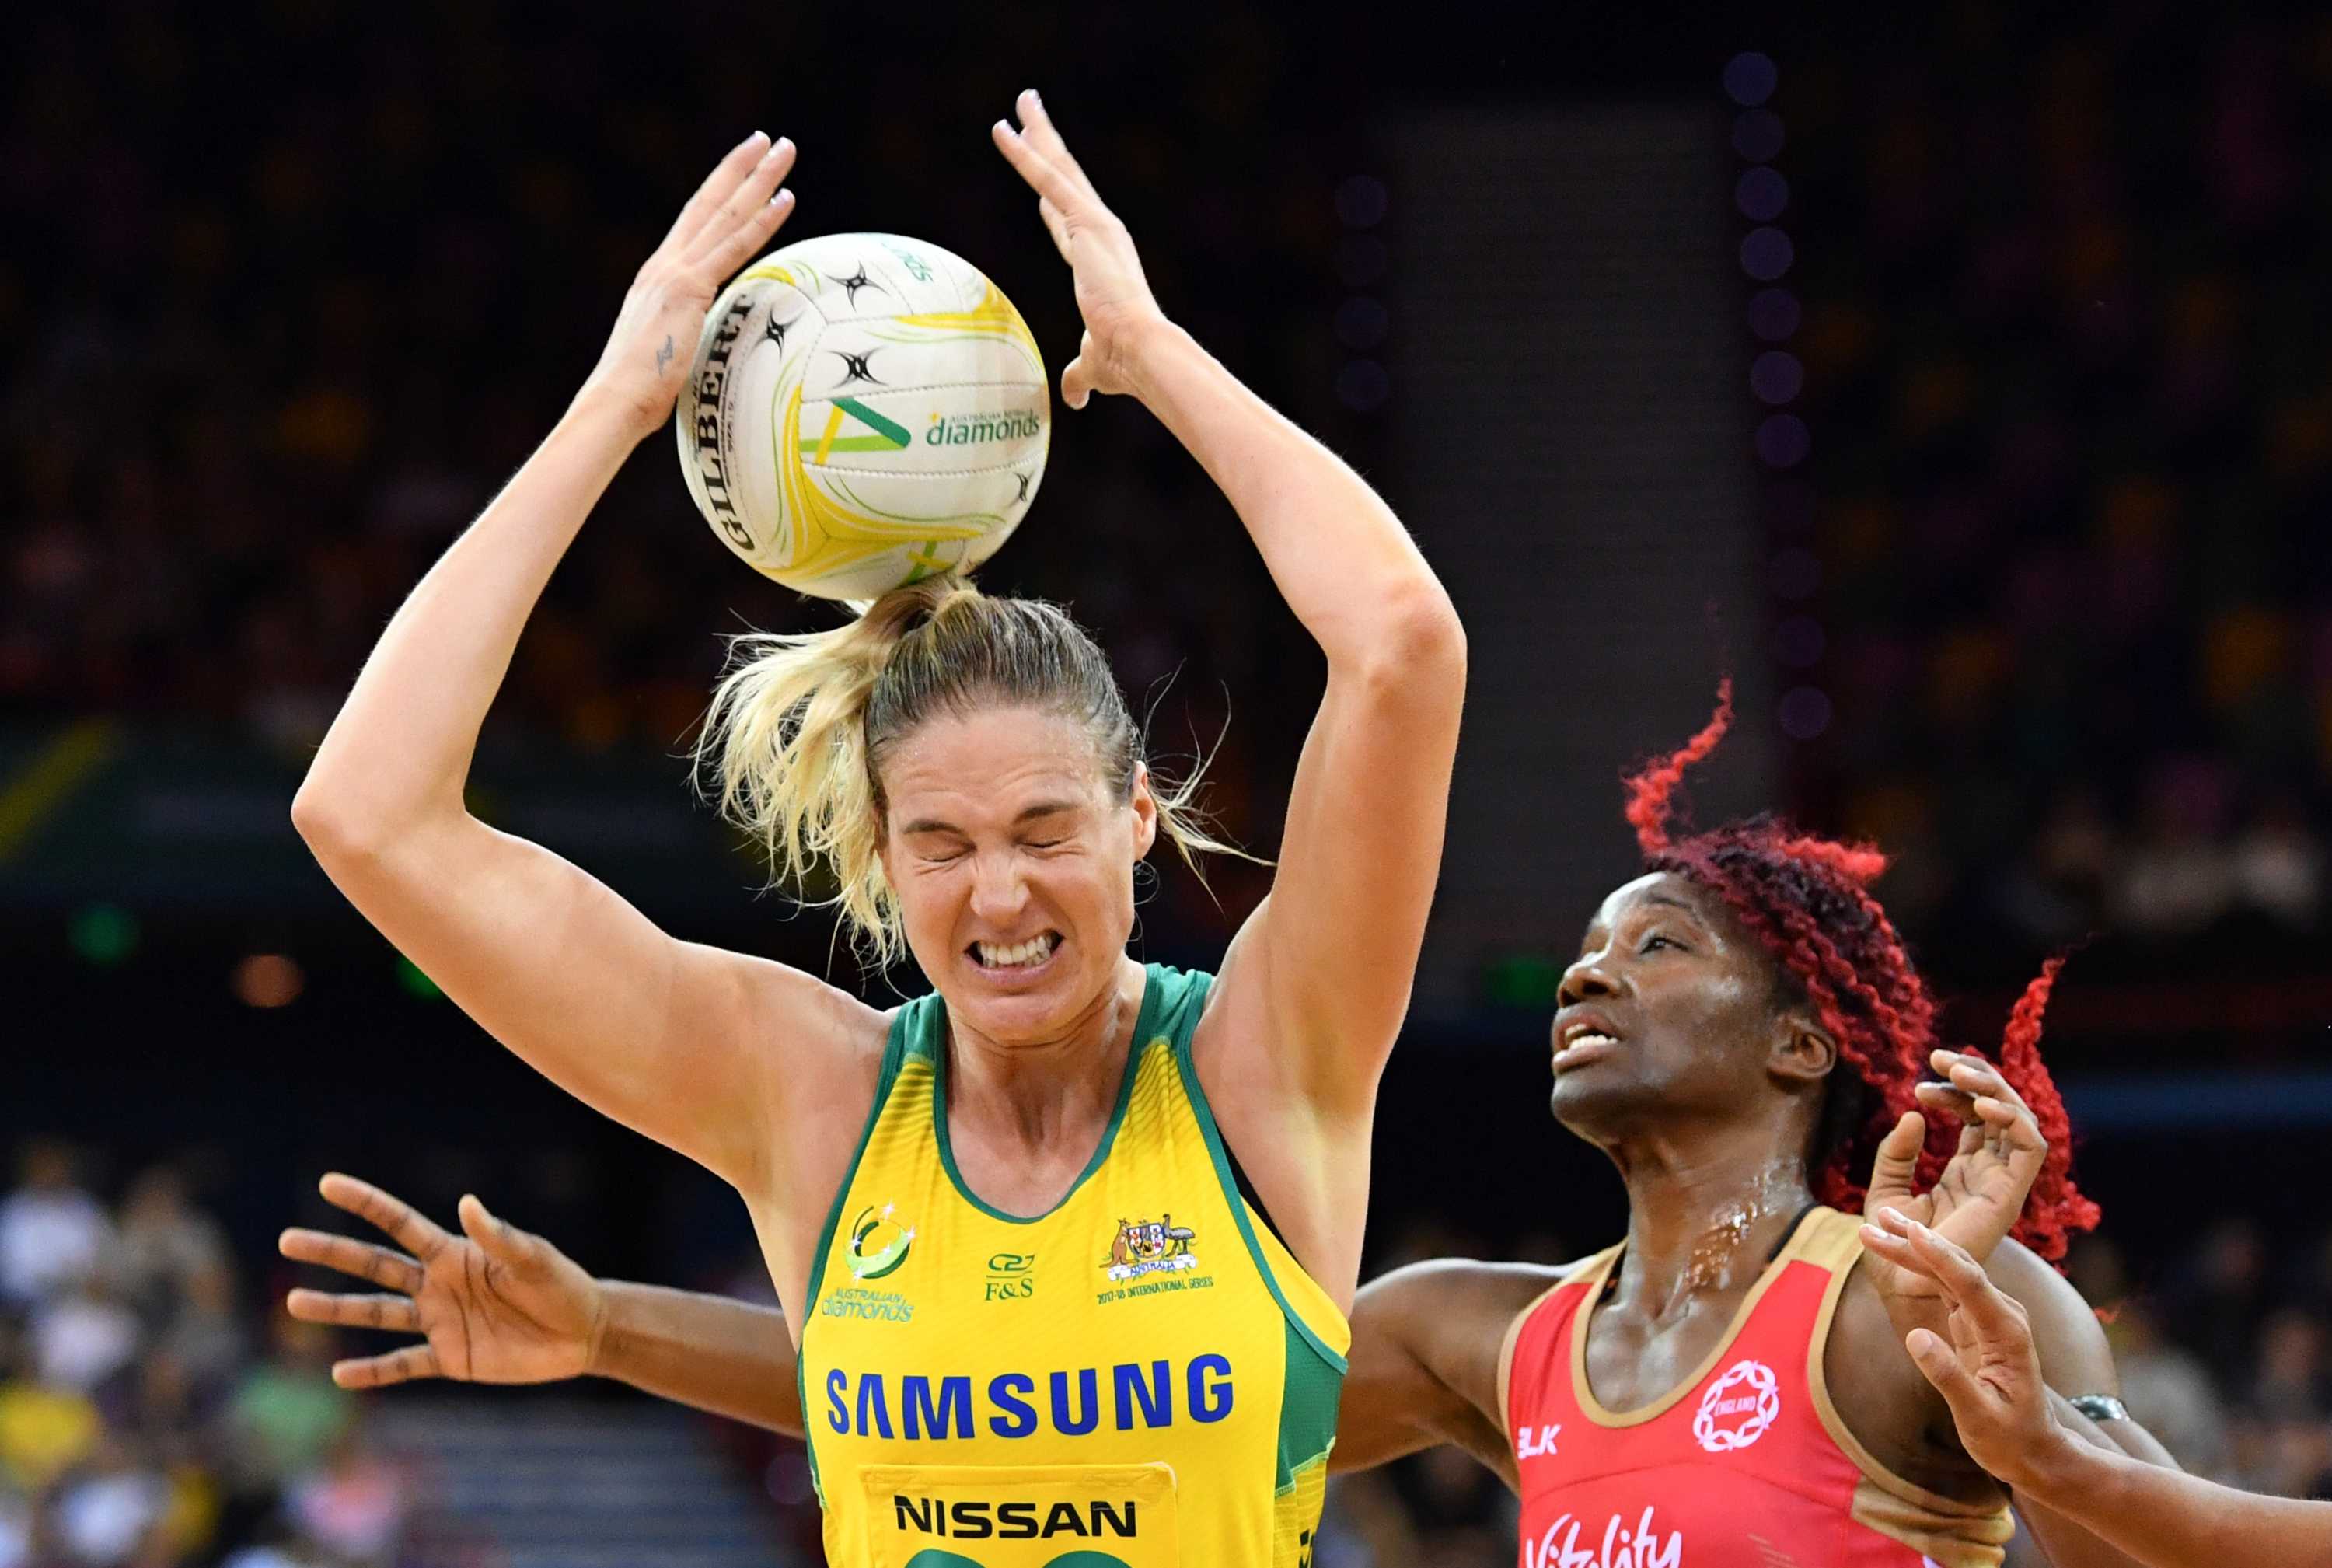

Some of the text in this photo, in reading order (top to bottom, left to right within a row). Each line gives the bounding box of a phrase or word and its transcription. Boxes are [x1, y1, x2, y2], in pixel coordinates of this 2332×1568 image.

[697, 293, 756, 550] GILBERT
[927, 408, 1039, 445] diamonds
[822, 1296, 914, 1322] diamonds
[986, 1278, 1032, 1301] F&S
[1097, 1276, 1213, 1304] 2017-18 INTERNATIONAL SERIES
[826, 1353, 1234, 1440] SAMSUNG
[894, 1495, 1137, 1538] NISSAN
[1526, 1506, 1682, 1568] Vtlity
